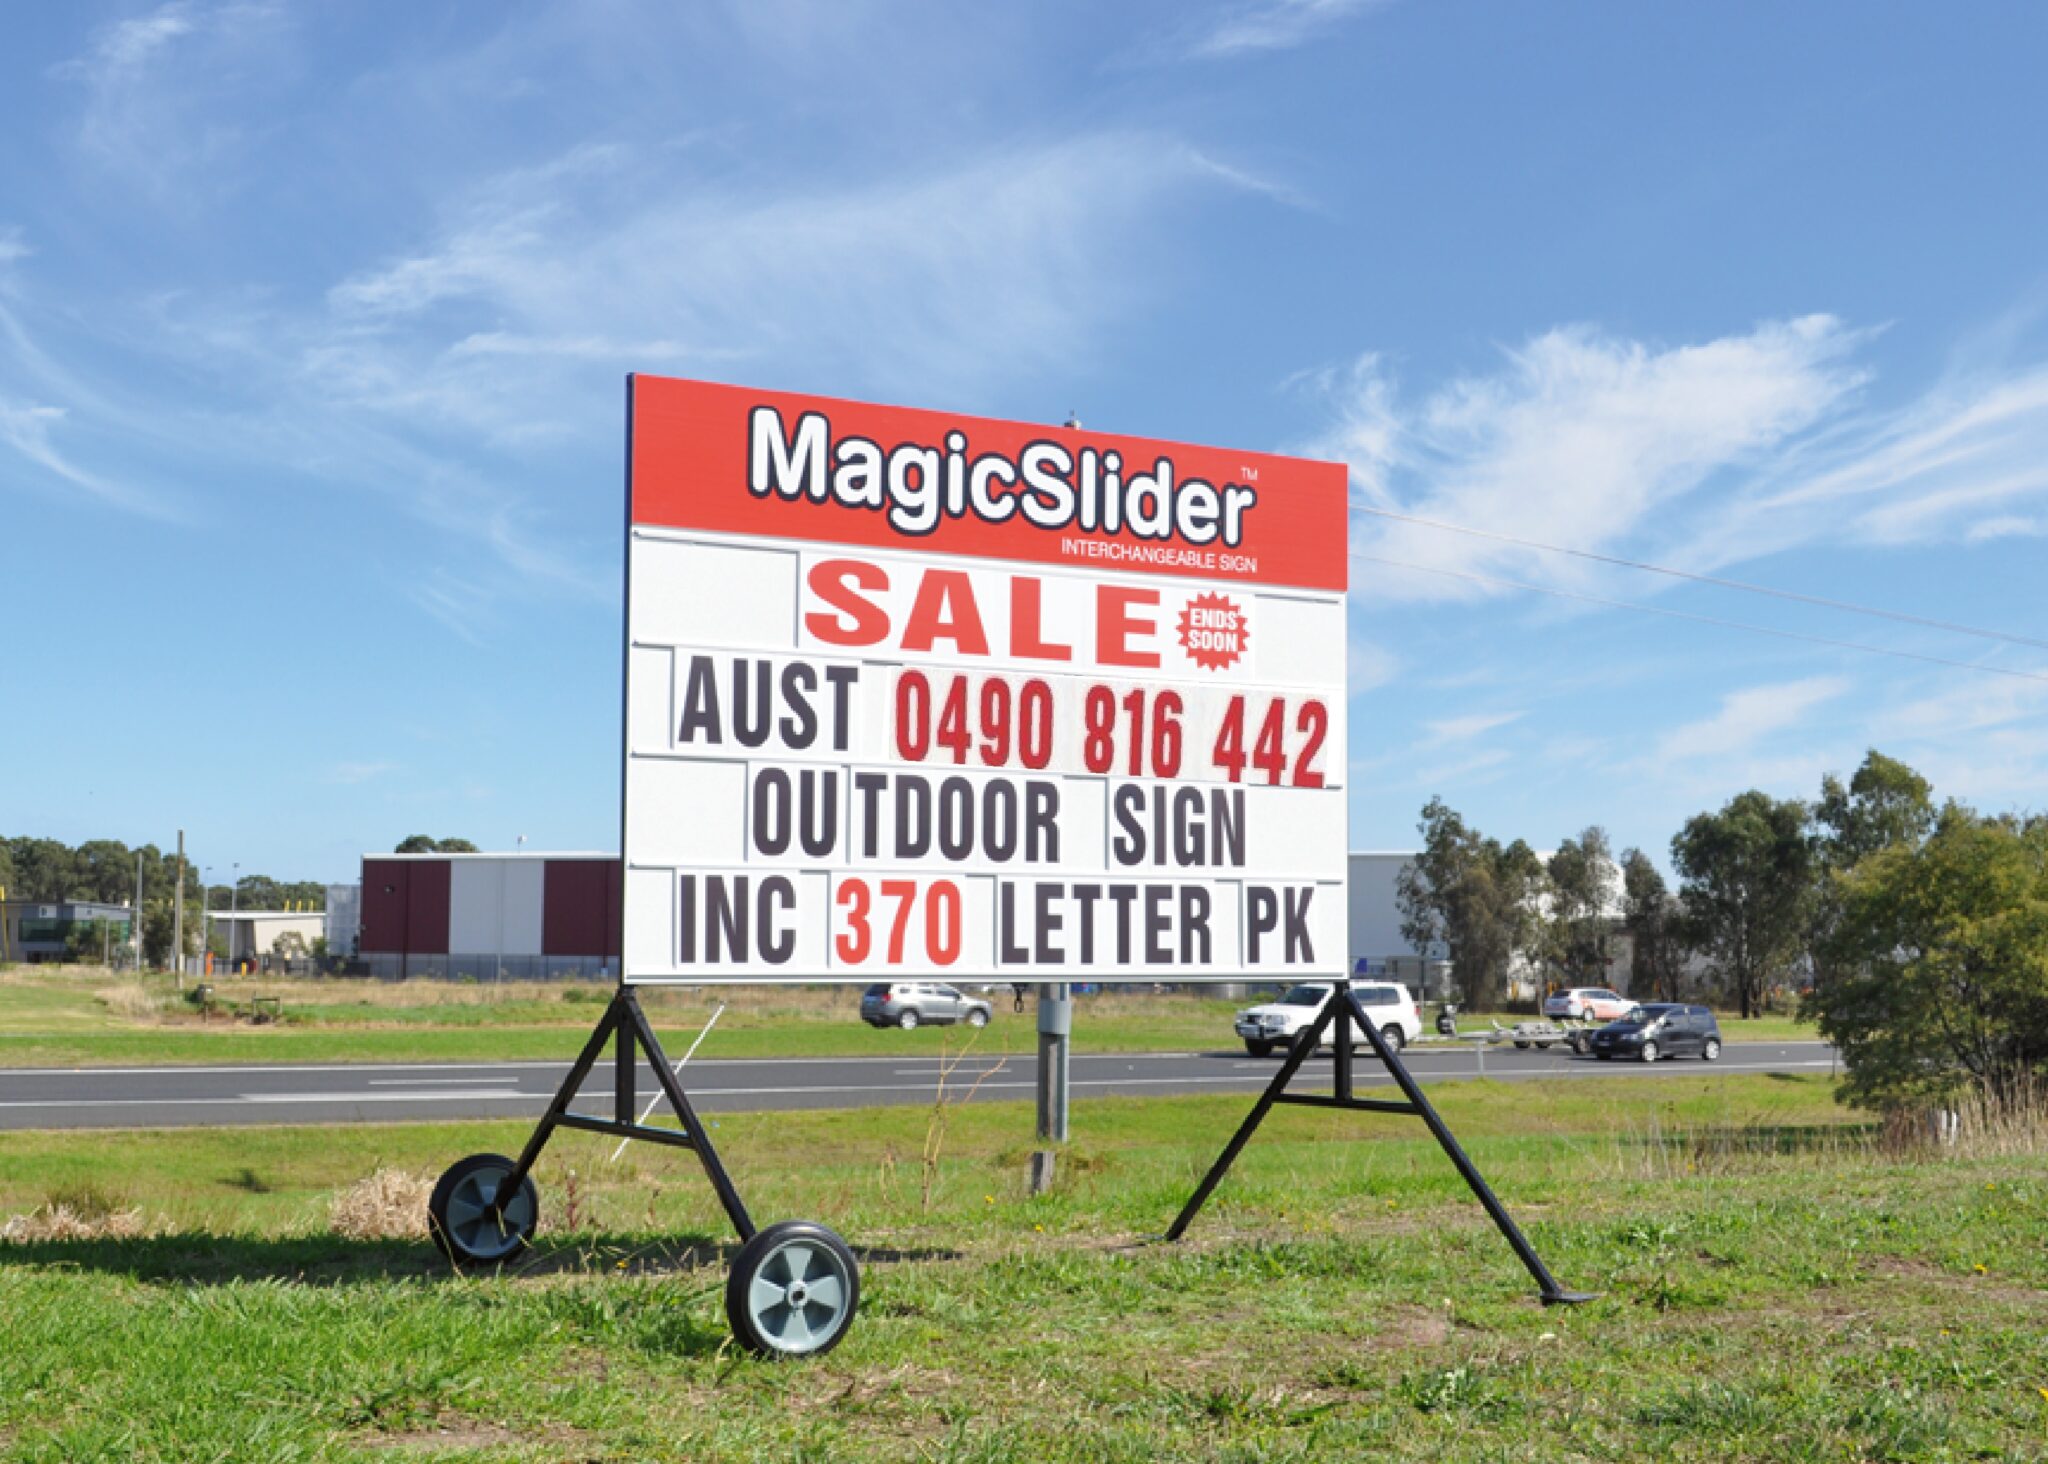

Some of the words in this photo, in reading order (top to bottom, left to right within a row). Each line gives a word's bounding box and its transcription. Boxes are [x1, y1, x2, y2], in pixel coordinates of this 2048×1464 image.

[748, 406, 1255, 548] MagicSlider
[1061, 538, 1215, 569] INTERCHANGEABLE
[1219, 554, 1257, 573] SIGN
[805, 559, 1161, 669] SALE
[1188, 629, 1238, 653] SOON
[1190, 607, 1238, 630] ENDS
[679, 656, 858, 752] AUST
[895, 669, 1054, 771] 0490
[1084, 684, 1182, 779] 816
[1212, 696, 1329, 789] 442
[753, 767, 1060, 864] OUTDOOR
[1114, 784, 1245, 867] SIGN
[680, 874, 795, 966] INC
[835, 877, 963, 967] 370
[1000, 881, 1212, 966] LETTER
[1247, 886, 1315, 965] PK
